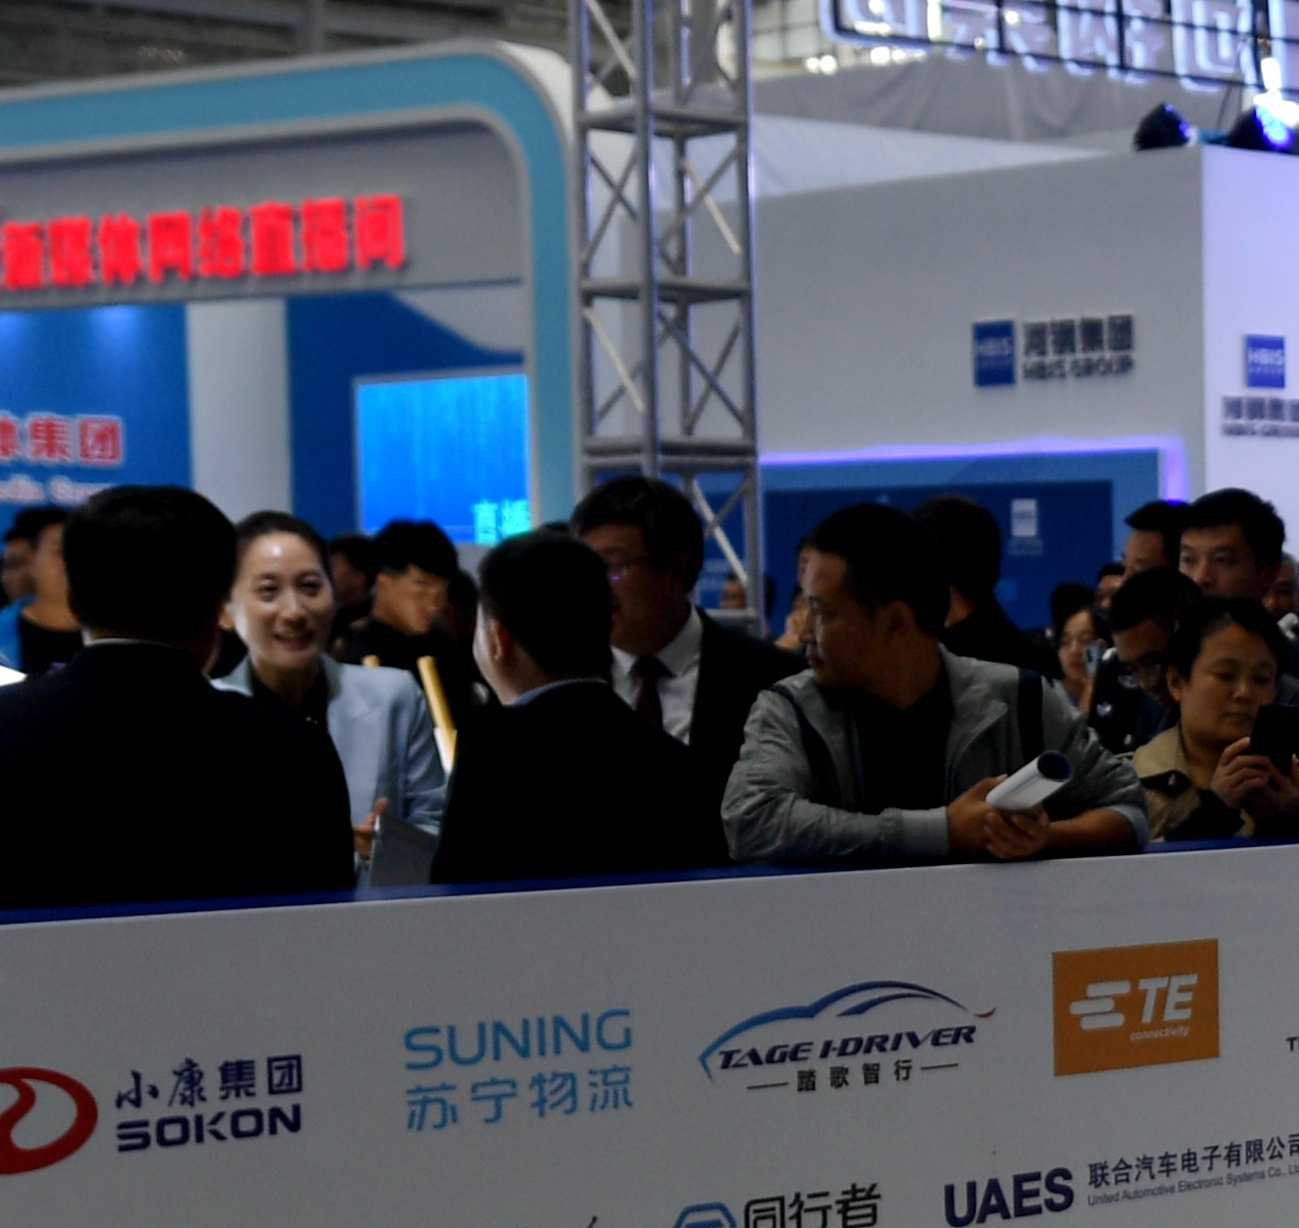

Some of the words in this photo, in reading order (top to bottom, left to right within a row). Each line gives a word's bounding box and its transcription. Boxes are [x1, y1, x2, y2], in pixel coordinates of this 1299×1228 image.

[1137, 973, 1198, 1023] TE
[404, 1008, 633, 1071] SUNING
[716, 1040, 815, 1071] TAGE
[1129, 1025, 1191, 1042] connectivity
[116, 1054, 303, 1110] 小康集团
[405, 1064, 634, 1132] 苏宁物流
[797, 1058, 915, 1093] 踏歌智行
[117, 1102, 302, 1153] SOKON
[943, 1167, 1075, 1228] UAES
